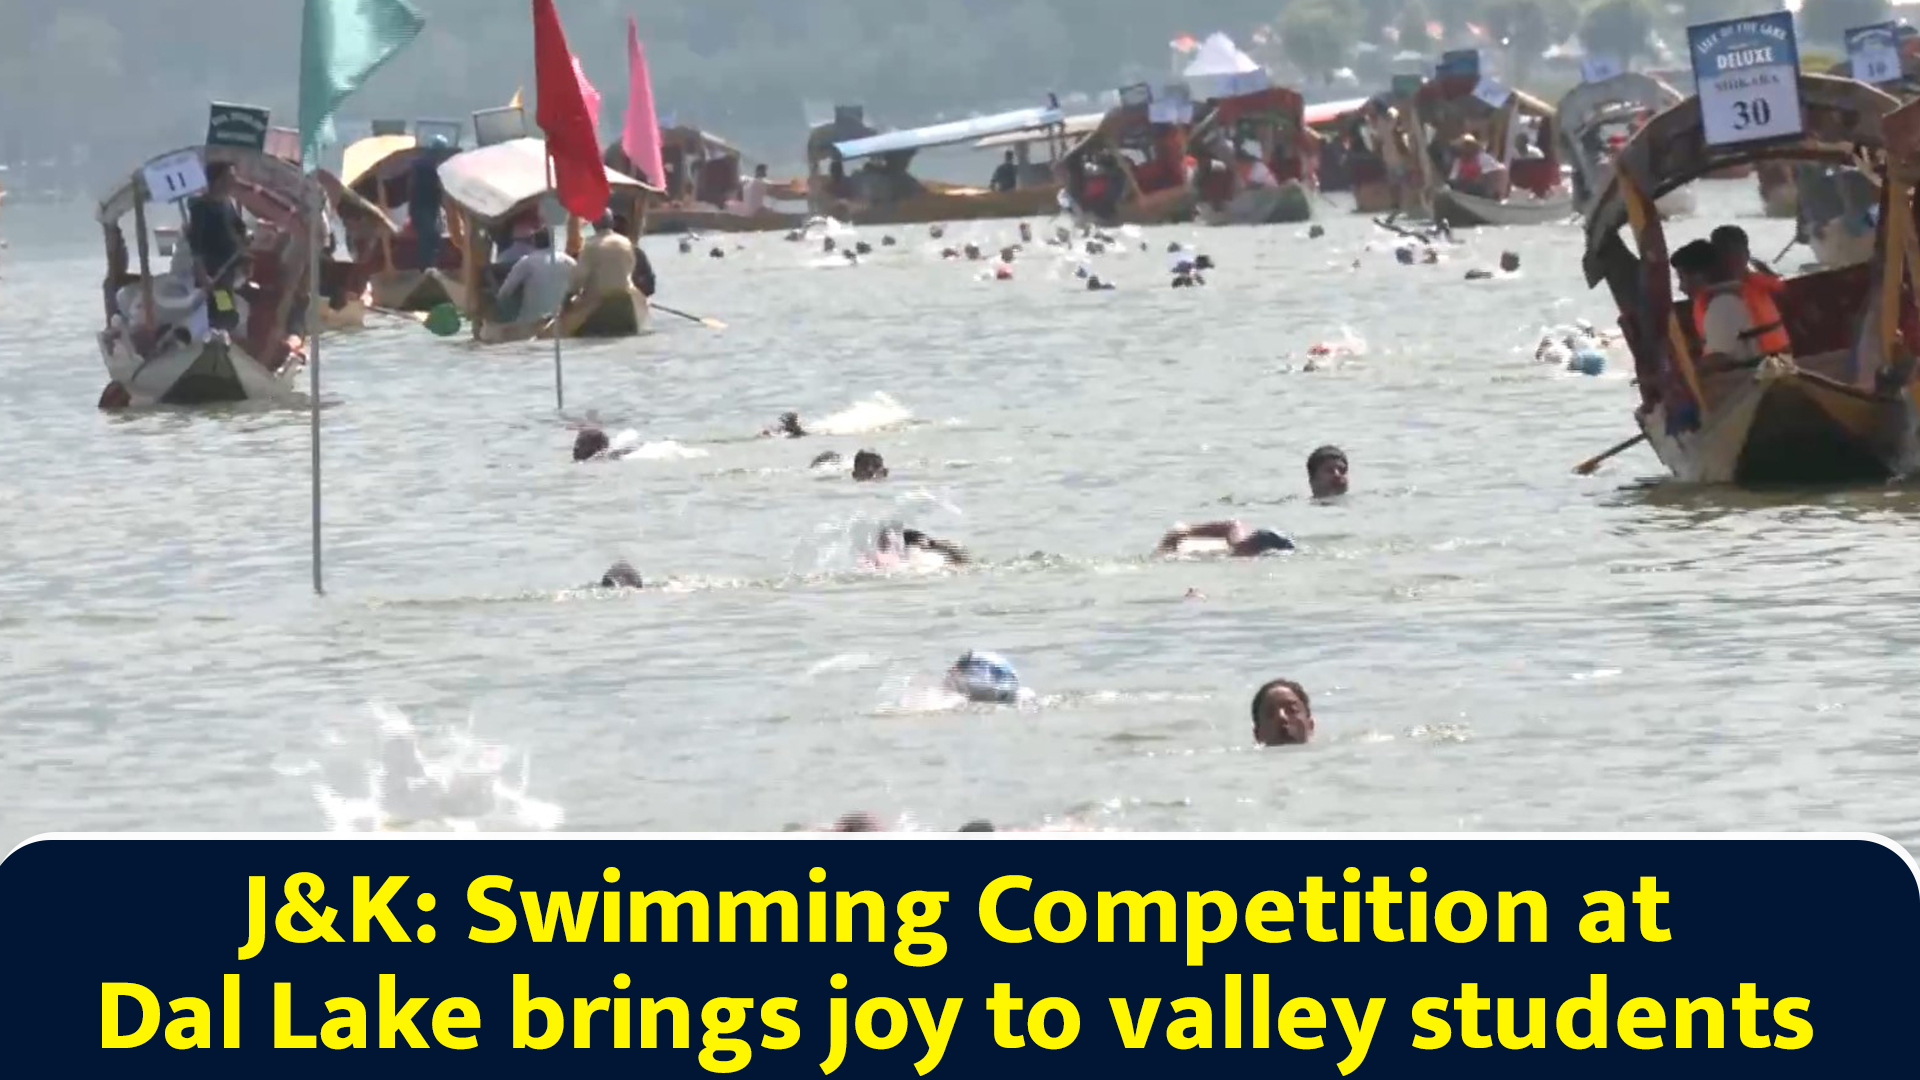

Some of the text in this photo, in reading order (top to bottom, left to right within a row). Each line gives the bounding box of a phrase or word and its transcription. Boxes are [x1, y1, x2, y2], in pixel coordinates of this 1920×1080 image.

[1717, 47, 1773, 69] DELUXE
[1733, 99, 1771, 130] 30
[166, 171, 187, 191] 11
